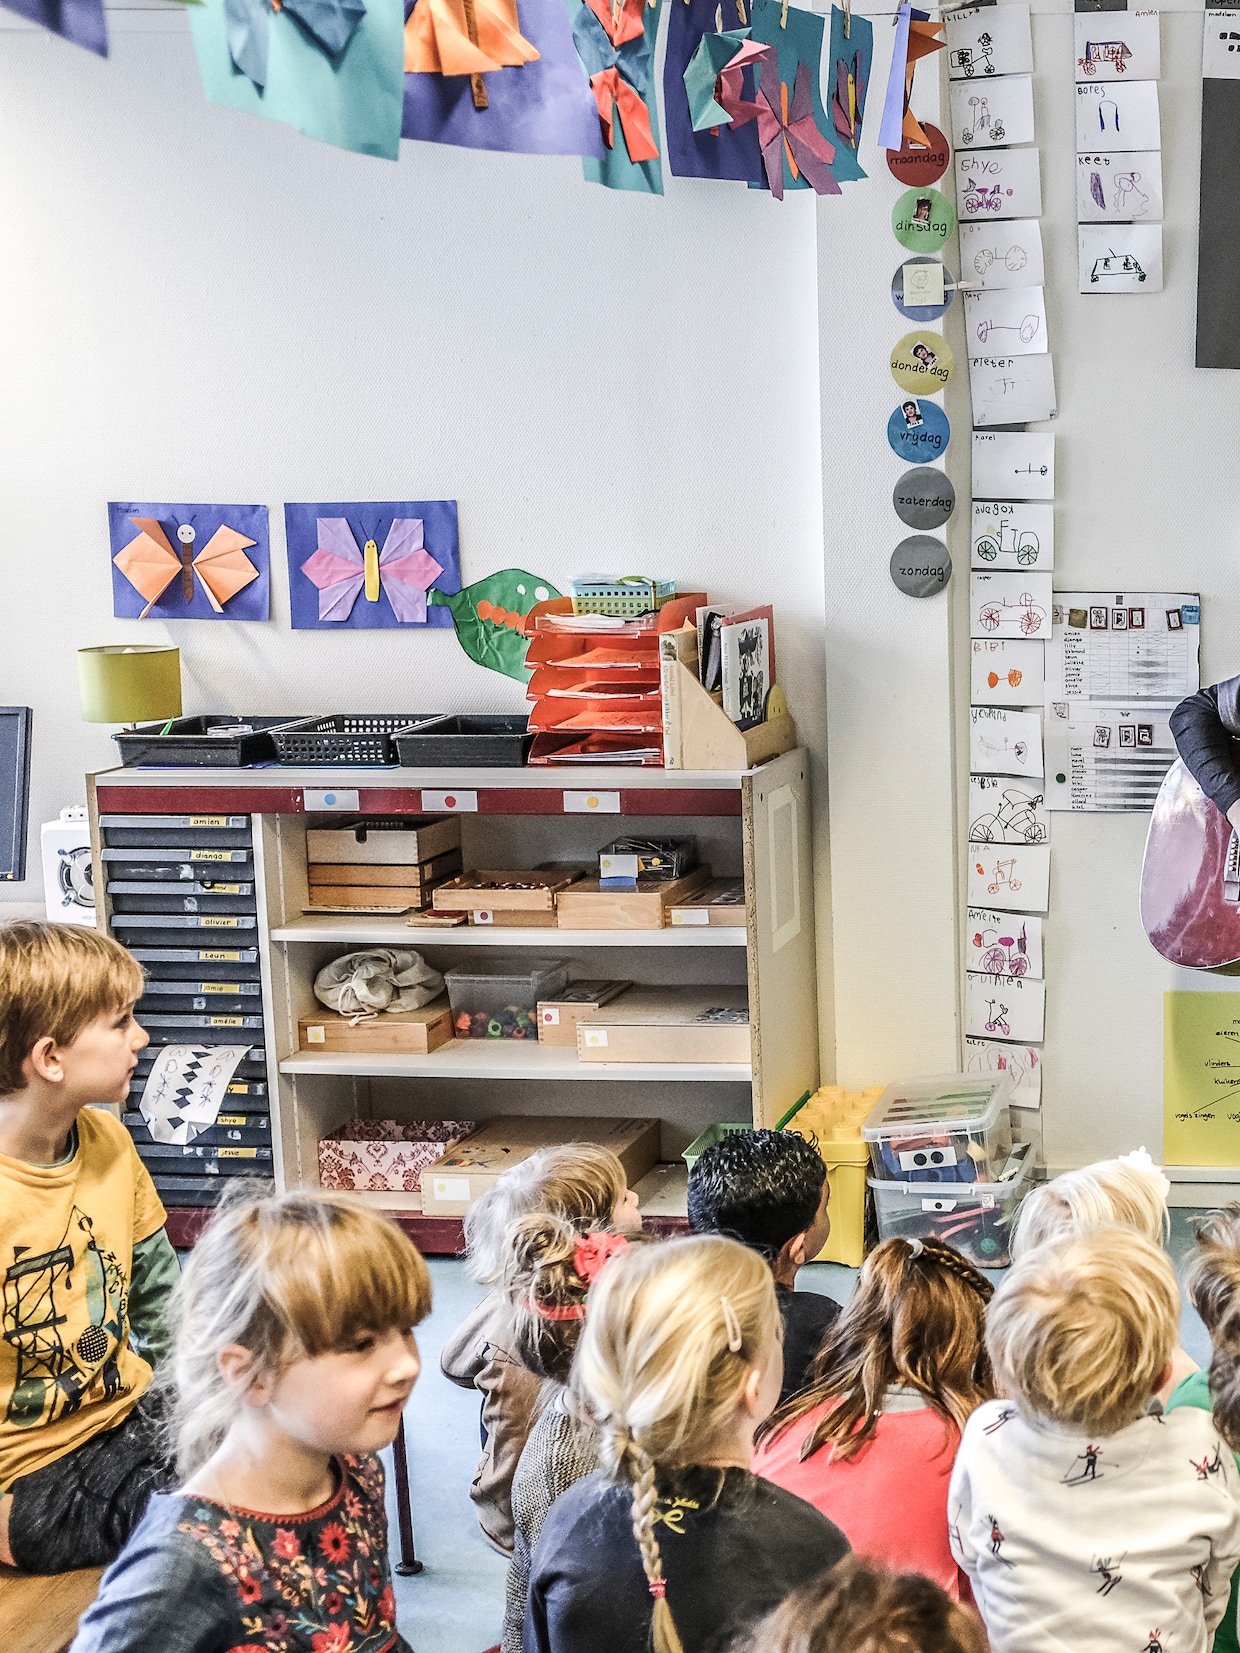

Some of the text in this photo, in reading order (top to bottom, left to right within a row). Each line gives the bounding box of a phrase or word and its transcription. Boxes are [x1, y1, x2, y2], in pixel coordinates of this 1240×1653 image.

[889, 151, 945, 167] maandag
[896, 220, 947, 237] dinsdag
[891, 360, 950, 382] donderdag
[898, 497, 952, 512] zaterdag
[899, 565, 945, 582] zondag
[193, 818, 220, 826] amien
[205, 918, 232, 926] olivier
[204, 952, 226, 960] teun
[1204, 1059, 1231, 1067] vlinders
[1194, 1113, 1216, 1122] zingen
